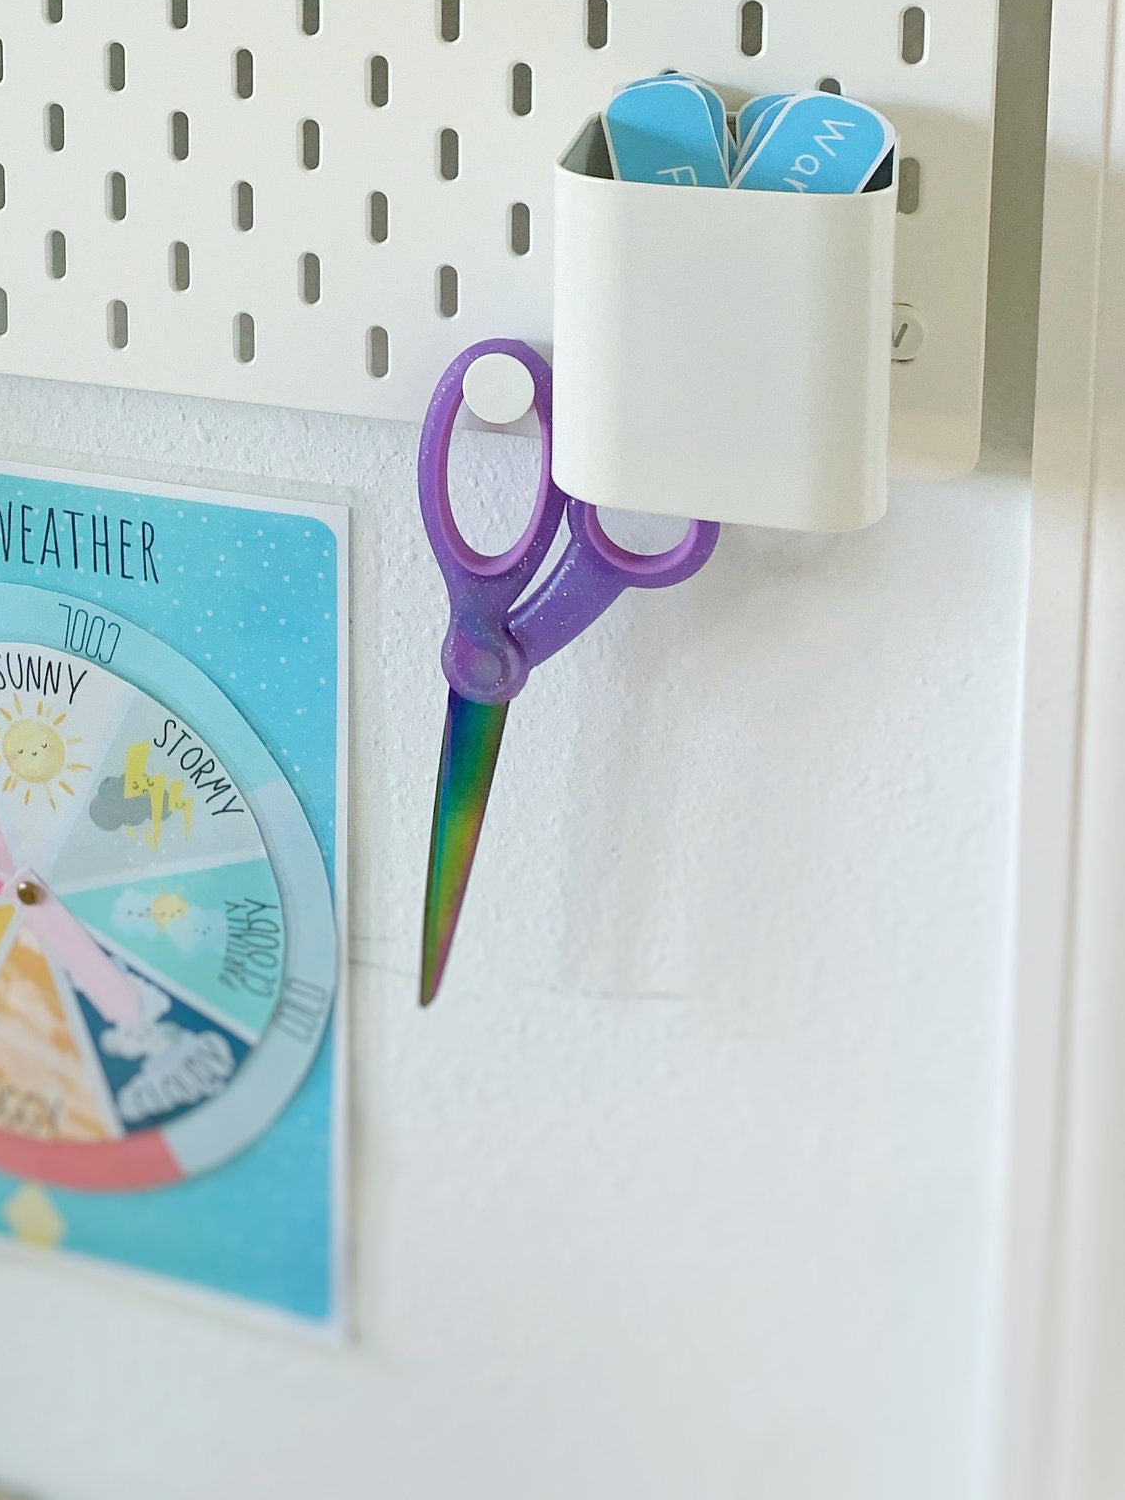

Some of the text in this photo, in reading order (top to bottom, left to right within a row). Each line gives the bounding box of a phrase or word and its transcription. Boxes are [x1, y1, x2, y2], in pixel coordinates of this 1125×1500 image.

[57, 602, 122, 664] COOL
[152, 718, 245, 819] STORMY
[239, 896, 281, 998] CLOUDY
